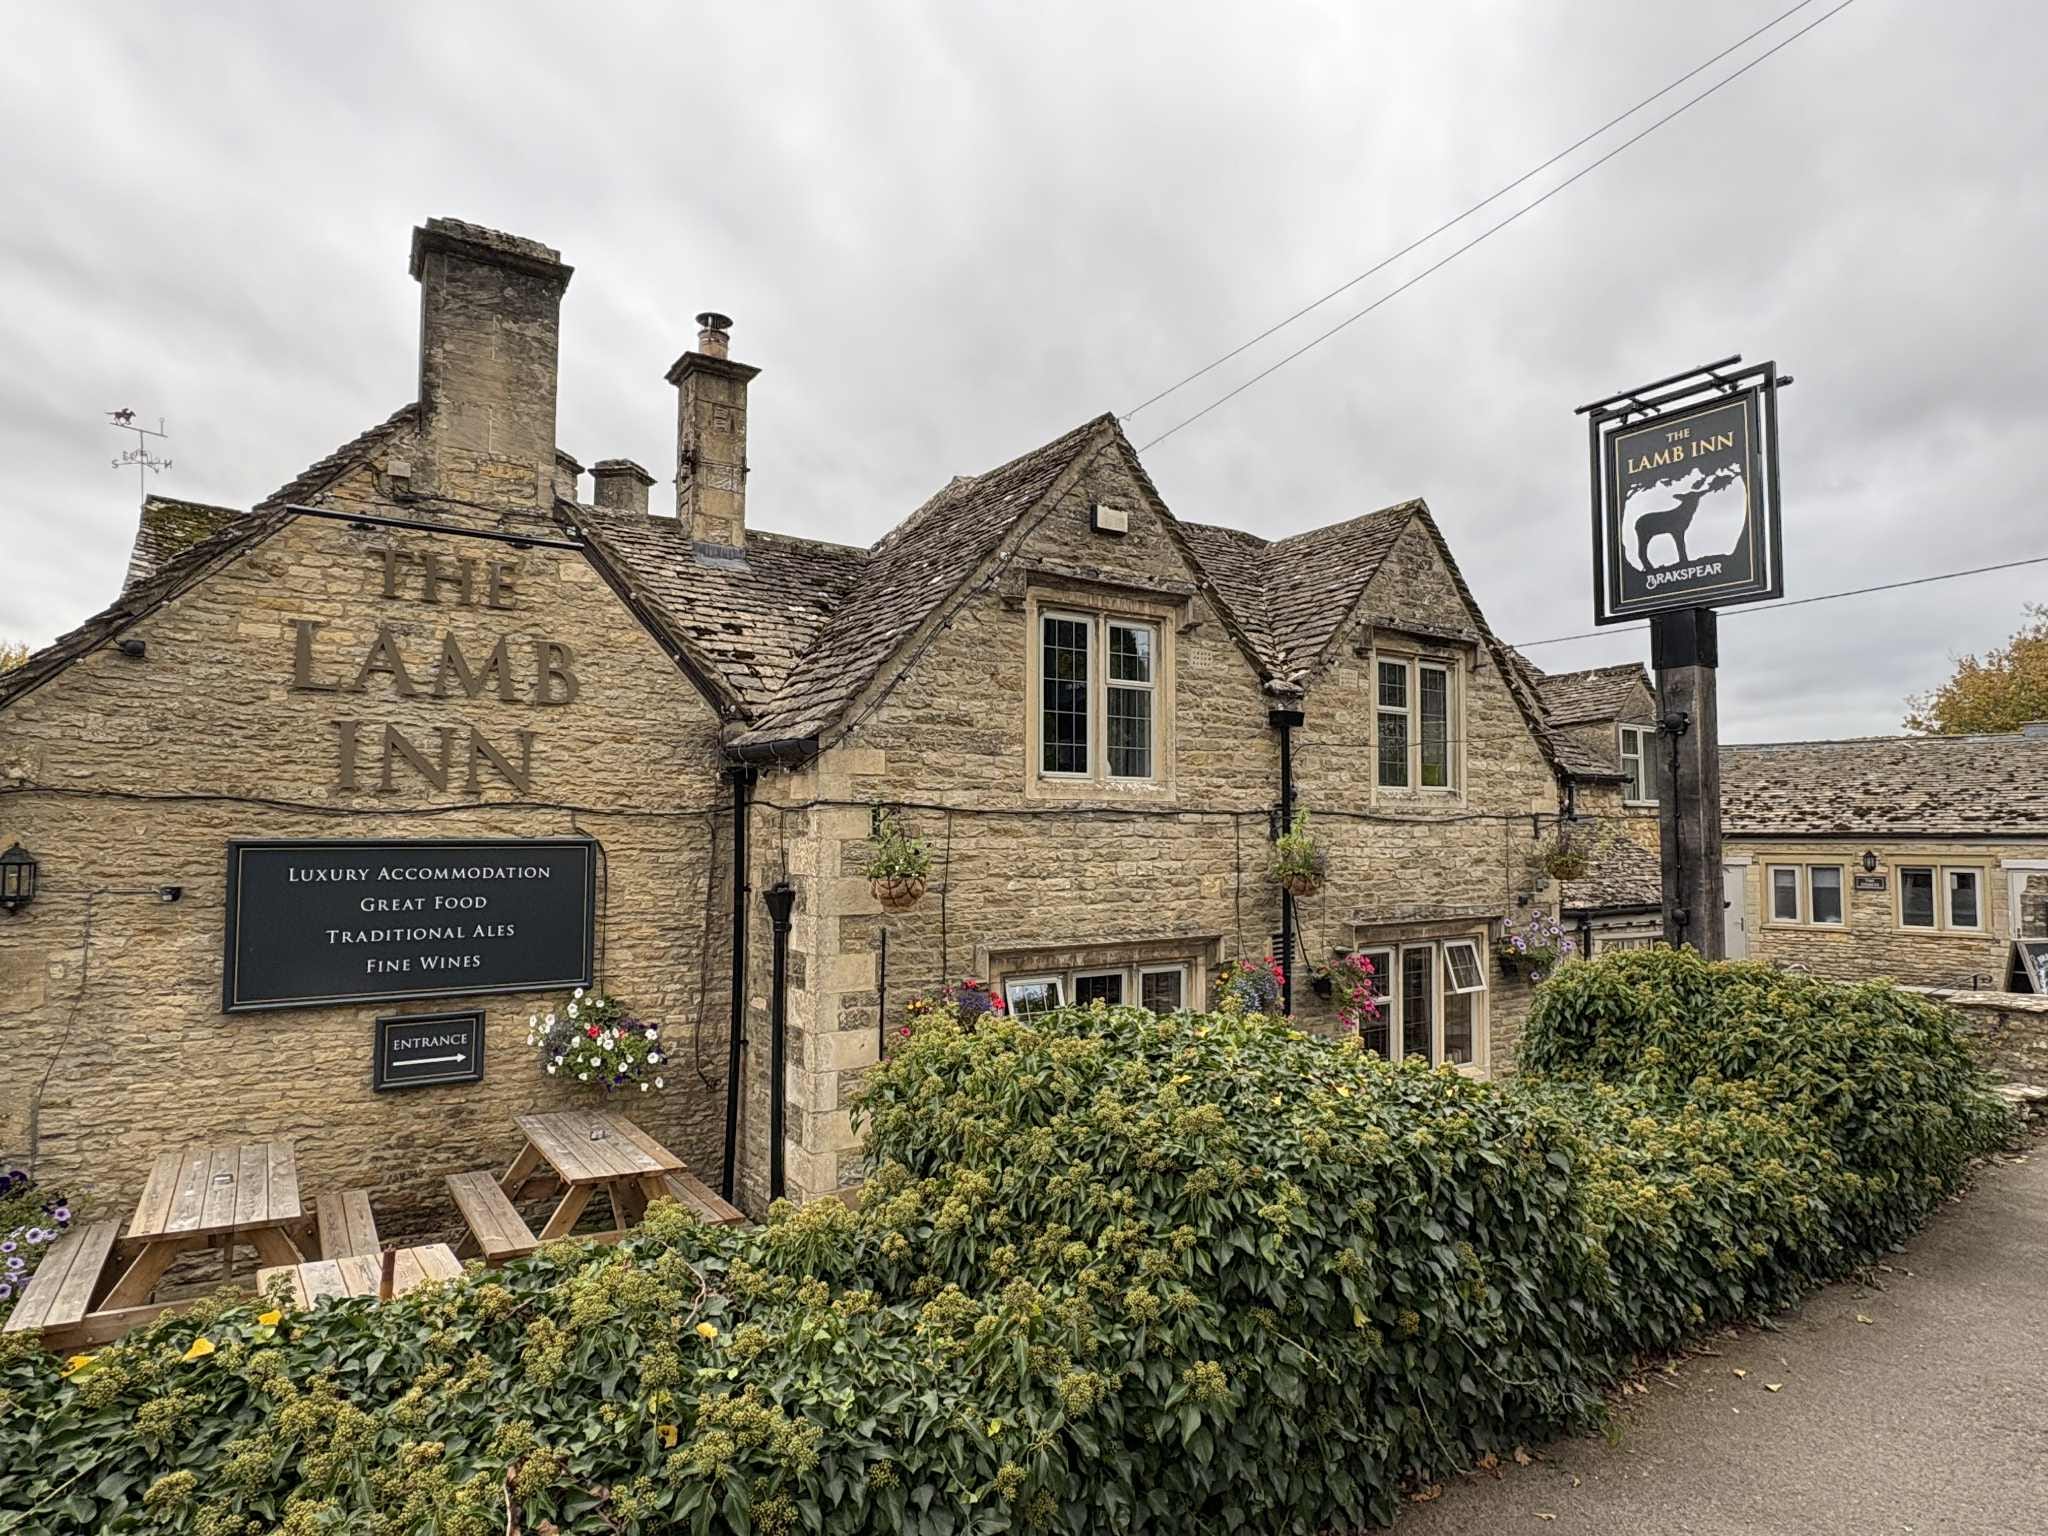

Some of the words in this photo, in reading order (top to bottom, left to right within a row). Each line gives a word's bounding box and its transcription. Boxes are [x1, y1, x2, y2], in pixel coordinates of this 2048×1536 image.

[1666, 427, 1691, 443] THE
[1627, 445, 1685, 475] LAMB
[1691, 431, 1734, 457] INN
[369, 550, 518, 611] THE
[1645, 562, 1723, 590] BRAKSPEAR
[288, 618, 580, 706] LAMB
[332, 720, 537, 796] INN
[289, 867, 370, 882] LUXURY
[377, 866, 550, 881] ACCOMMODATION
[360, 897, 425, 912] GREAT
[435, 896, 487, 910] FOOD
[326, 927, 465, 944] TRADITIONAL
[472, 924, 515, 938] ALES
[366, 958, 411, 973] FINE
[420, 955, 481, 970] WINES
[393, 1033, 467, 1051] ENTRANCE
